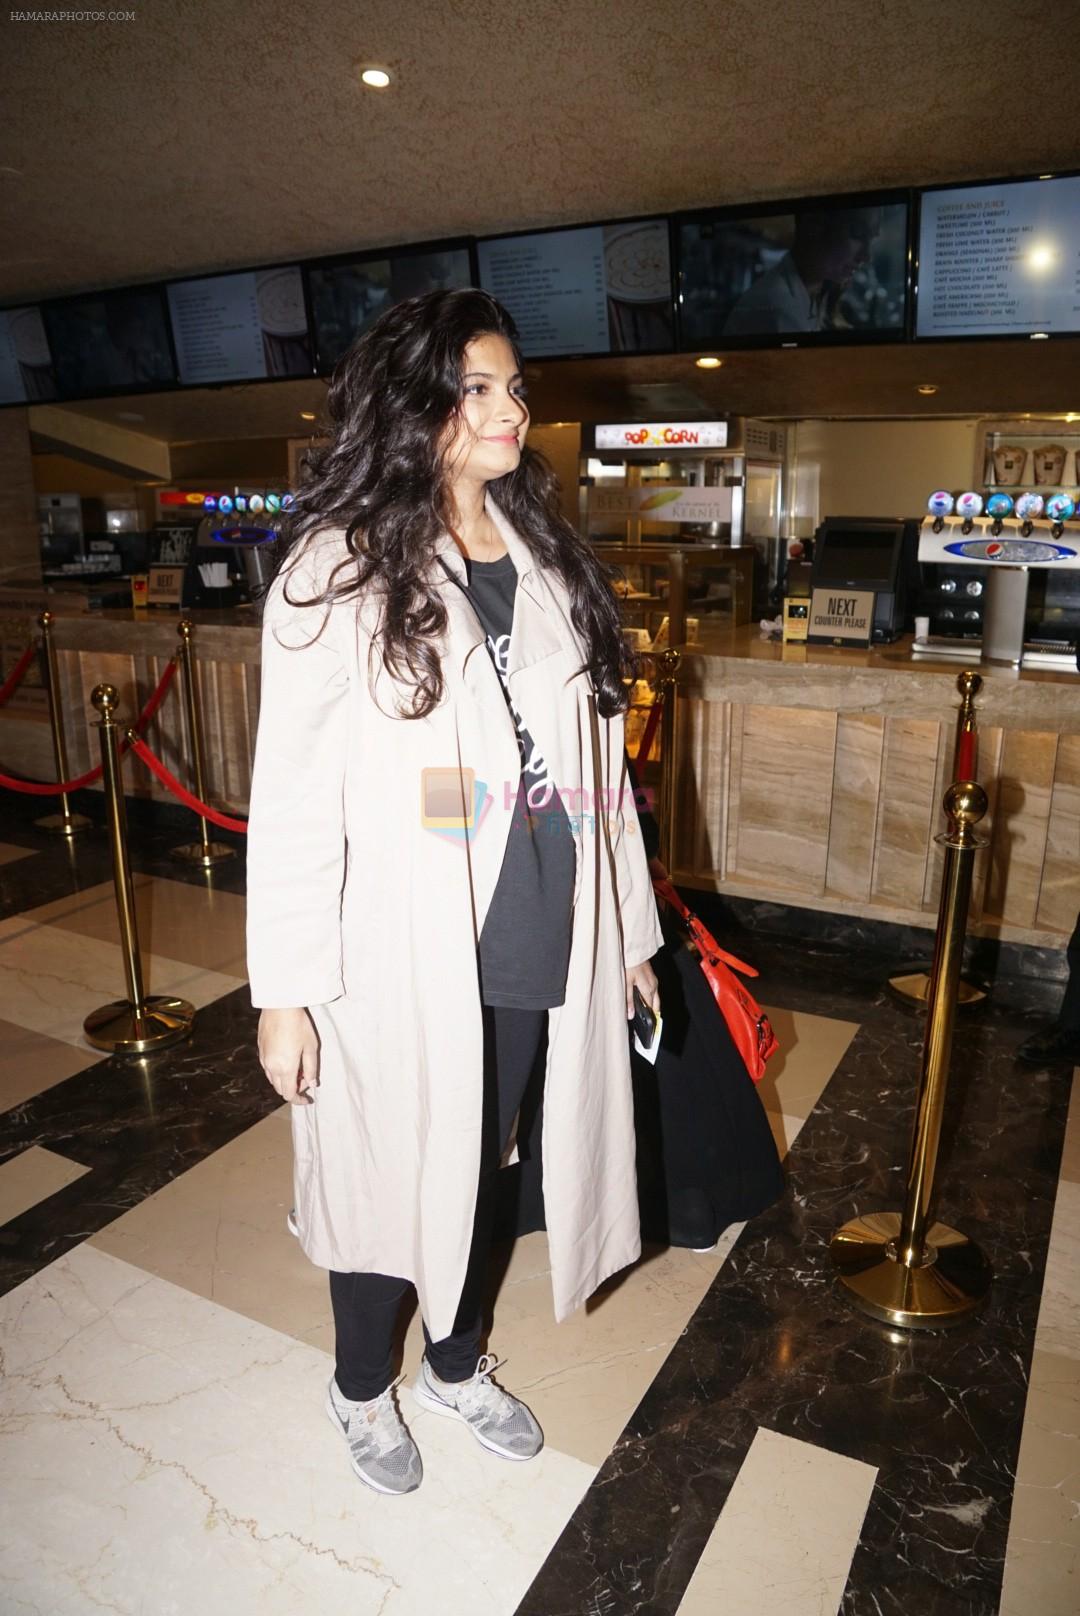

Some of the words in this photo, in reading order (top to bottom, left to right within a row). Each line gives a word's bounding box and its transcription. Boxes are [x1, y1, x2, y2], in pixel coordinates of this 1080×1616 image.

[625, 428, 648, 444] POP
[663, 427, 699, 444] CORN
[827, 597, 857, 616] NEXT
[814, 615, 843, 627] COUNTER
[844, 617, 866, 629] PLEASE
